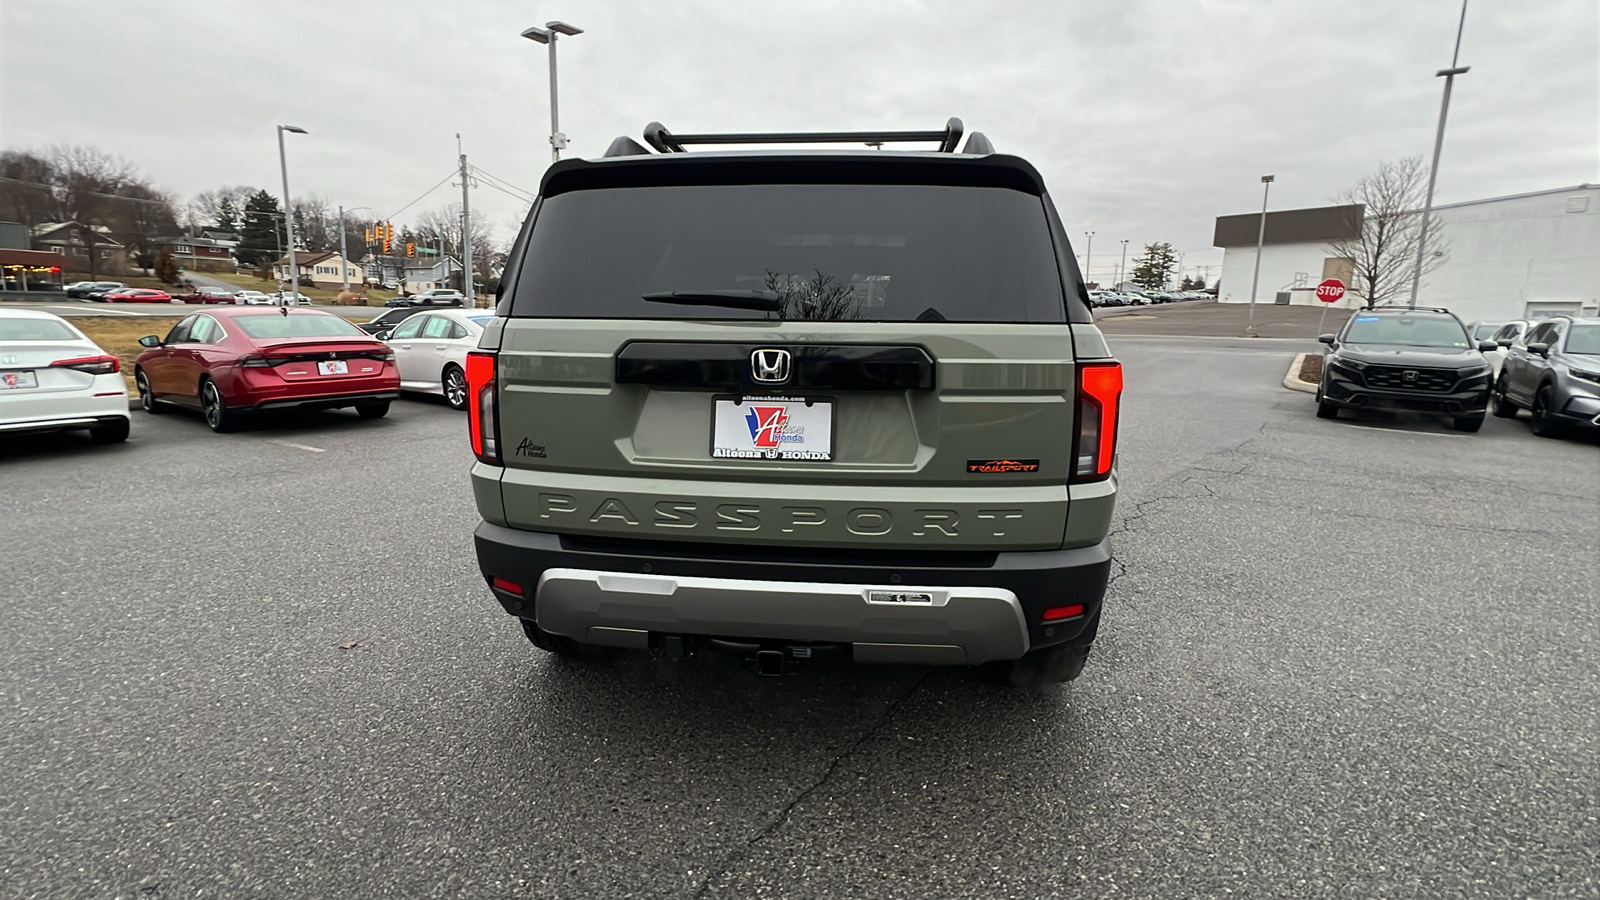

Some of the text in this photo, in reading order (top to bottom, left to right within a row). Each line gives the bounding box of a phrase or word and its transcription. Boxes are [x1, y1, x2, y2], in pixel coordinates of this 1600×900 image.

[1317, 285, 1344, 296] STOP
[773, 433, 803, 442] Honda
[713, 448, 761, 459] Altoona
[782, 451, 831, 460] HONDA
[969, 464, 1038, 473] TRAILSPORT
[538, 492, 1023, 536] PASSPORT
